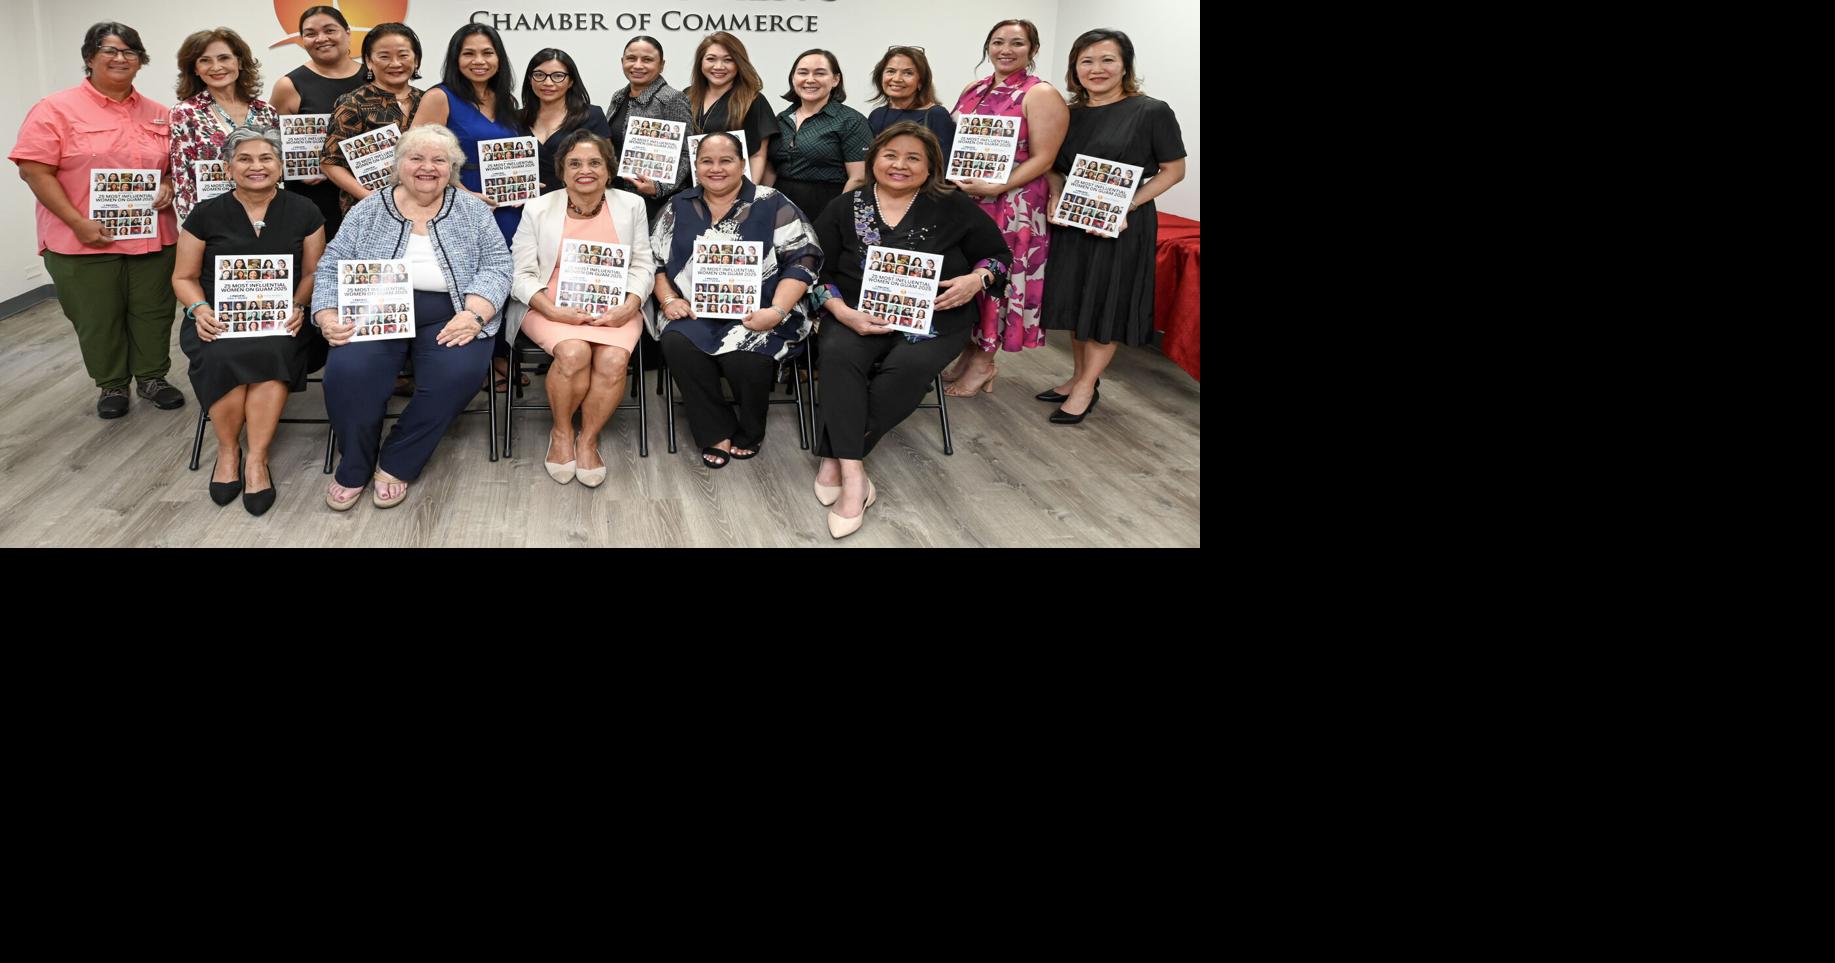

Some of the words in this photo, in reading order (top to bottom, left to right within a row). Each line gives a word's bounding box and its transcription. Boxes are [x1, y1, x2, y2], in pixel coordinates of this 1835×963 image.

[469, 10, 608, 31] CHAMBER
[616, 13, 651, 30] OF
[661, 10, 818, 32] COMMERCE
